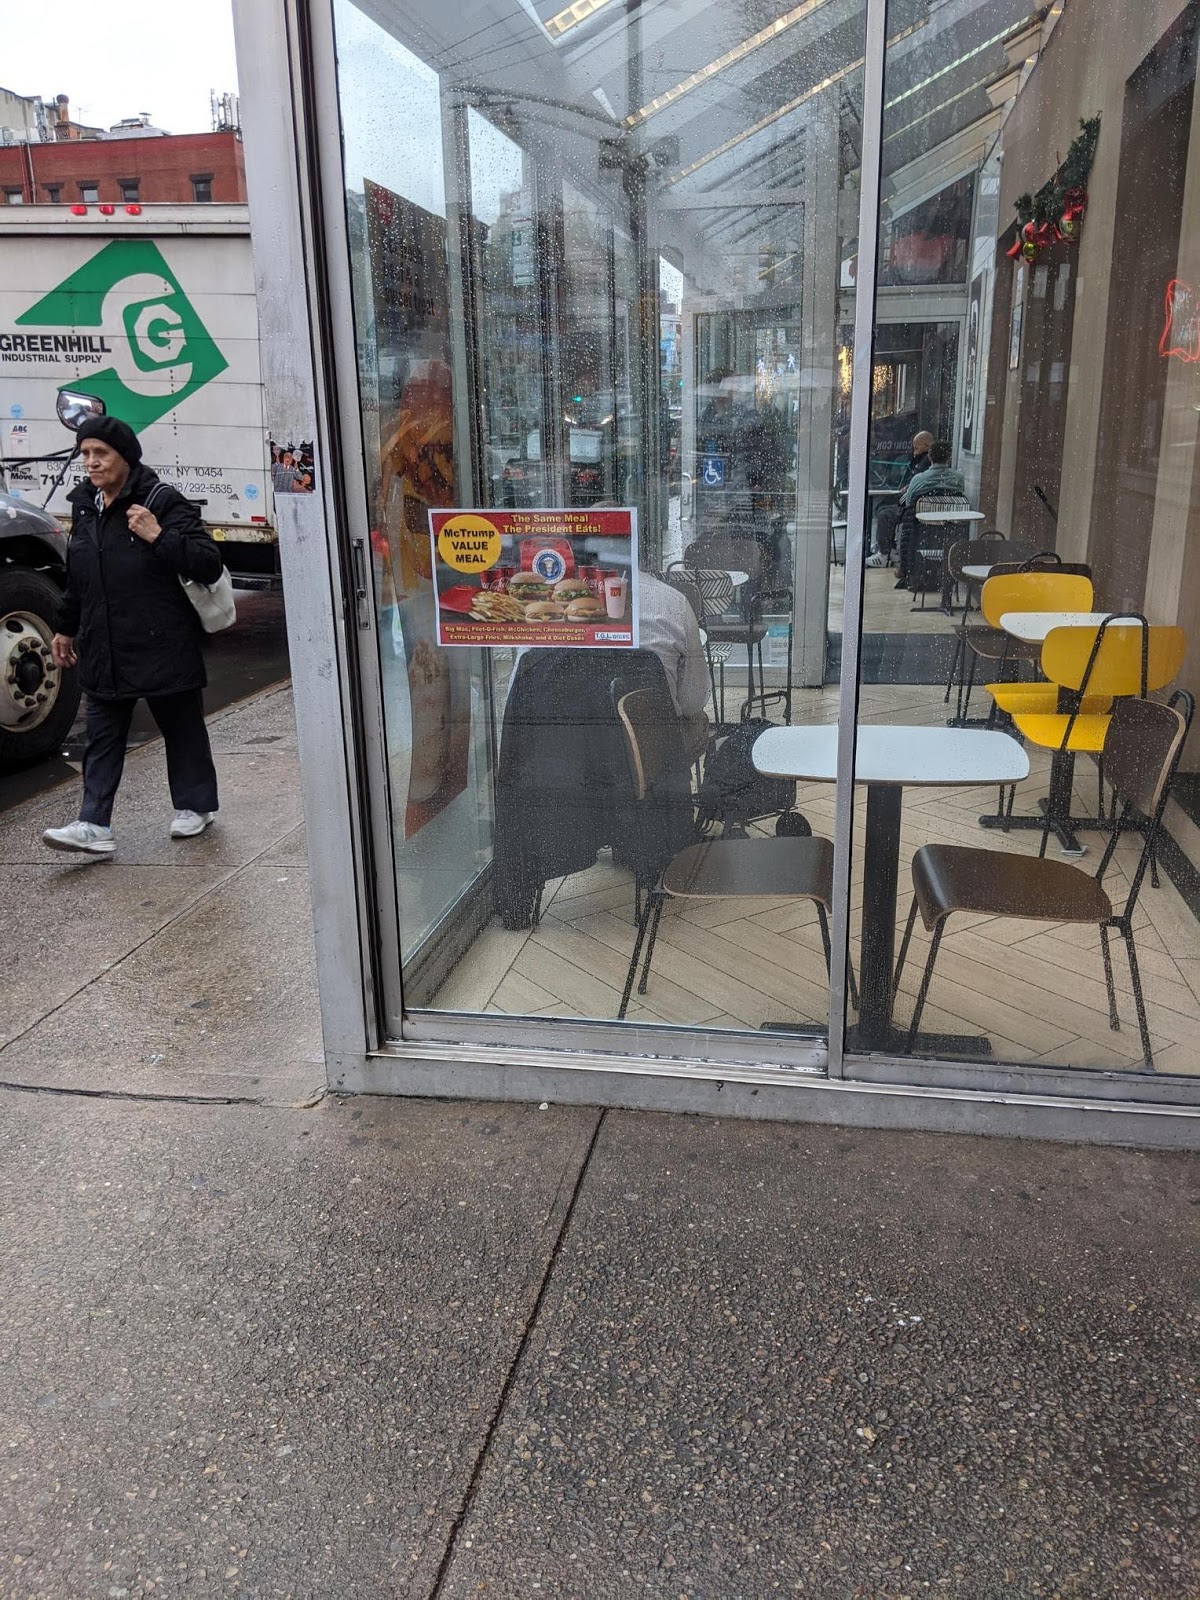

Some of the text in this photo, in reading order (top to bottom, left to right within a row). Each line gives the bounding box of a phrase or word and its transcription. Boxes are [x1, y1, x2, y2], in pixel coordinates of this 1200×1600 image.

[0, 334, 112, 353] GREENHILL
[2, 353, 102, 363] INDUSTRIAL SUPPLY
[13, 425, 28, 433] ABC
[70, 463, 88, 471] Eas
[154, 467, 173, 476] onx,
[177, 466, 190, 477] NY
[194, 467, 223, 477] 10454
[511, 514, 589, 523] The Same Meal
[444, 528, 495, 539] McTrump
[503, 524, 602, 533] The President Eats!
[451, 541, 488, 551] VALUE
[455, 554, 487, 563] MEAL
